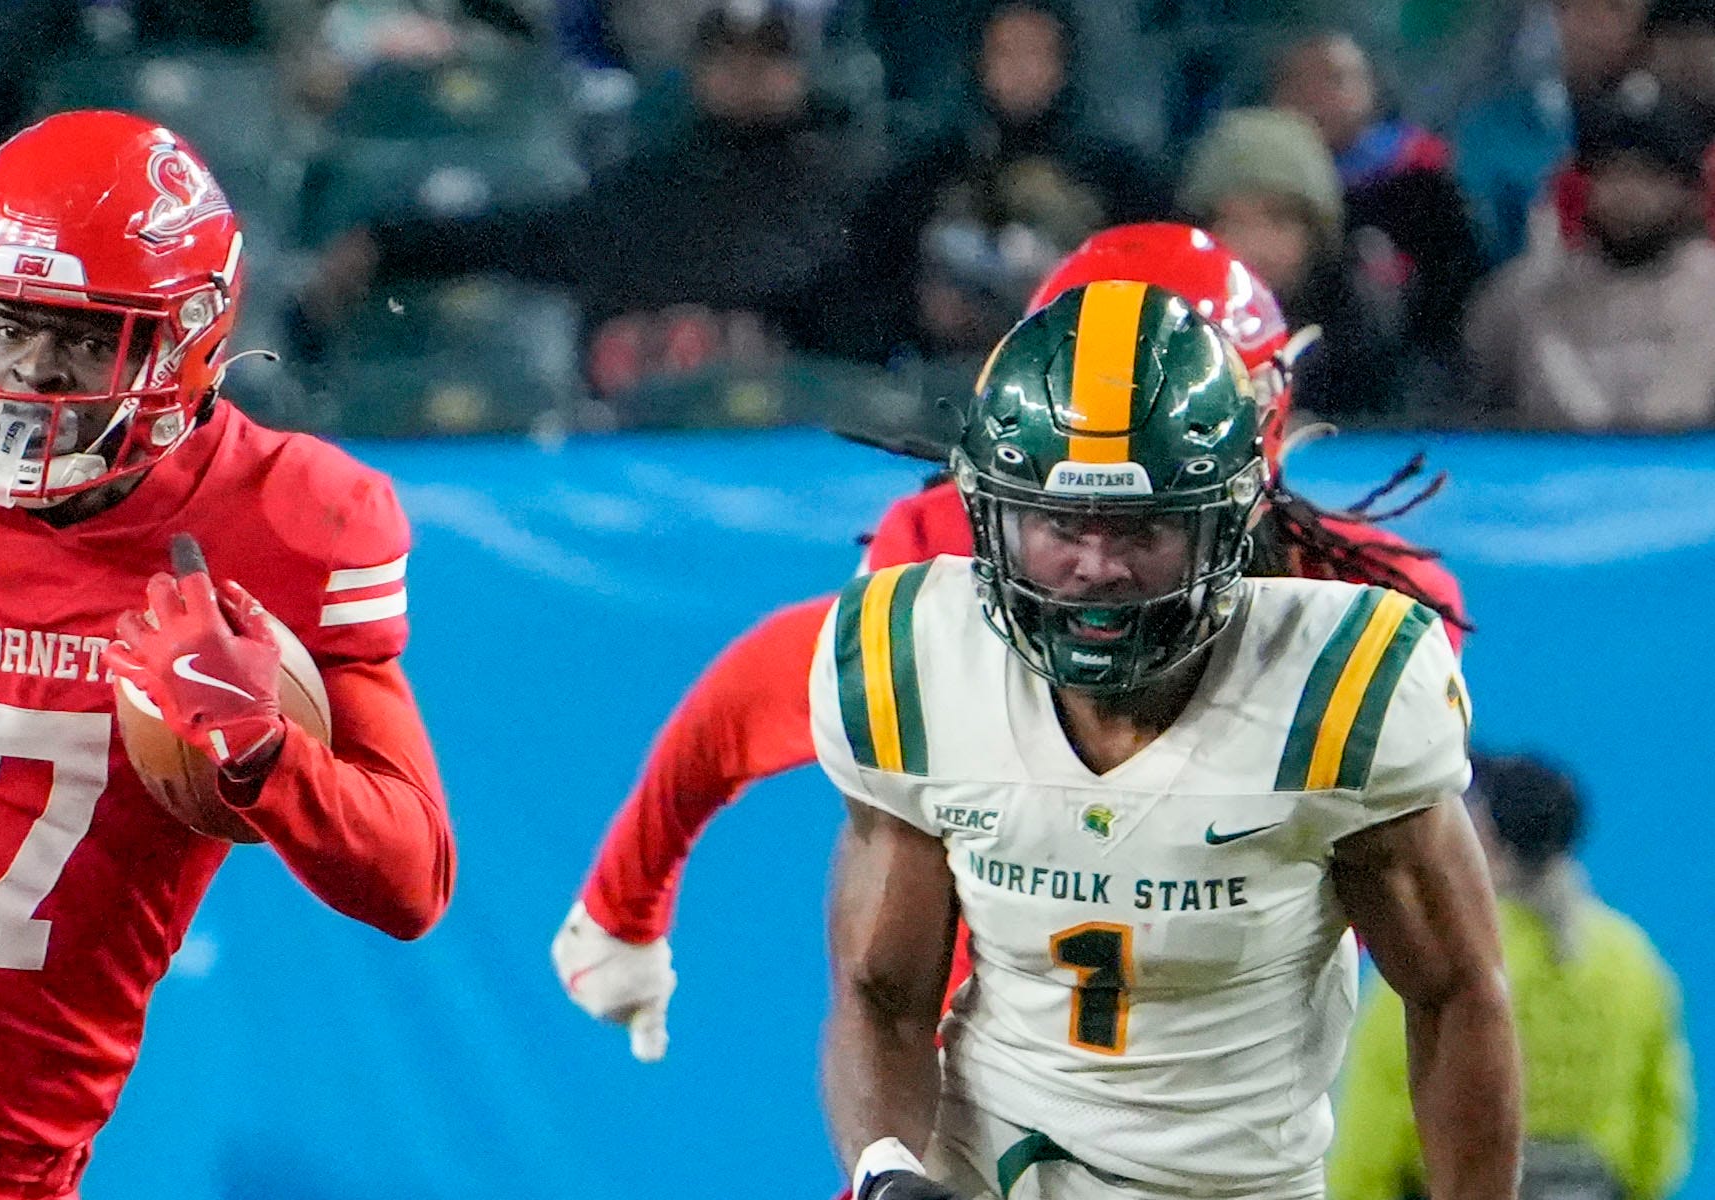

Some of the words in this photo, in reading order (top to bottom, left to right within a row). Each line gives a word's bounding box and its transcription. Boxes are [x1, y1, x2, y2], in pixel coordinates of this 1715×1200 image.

[1058, 471, 1135, 487] SPARTANS
[934, 804, 1000, 831] MEAC
[969, 851, 1113, 904] NORFOLK
[1134, 876, 1250, 912] STATE
[1050, 920, 1133, 1056] 1
